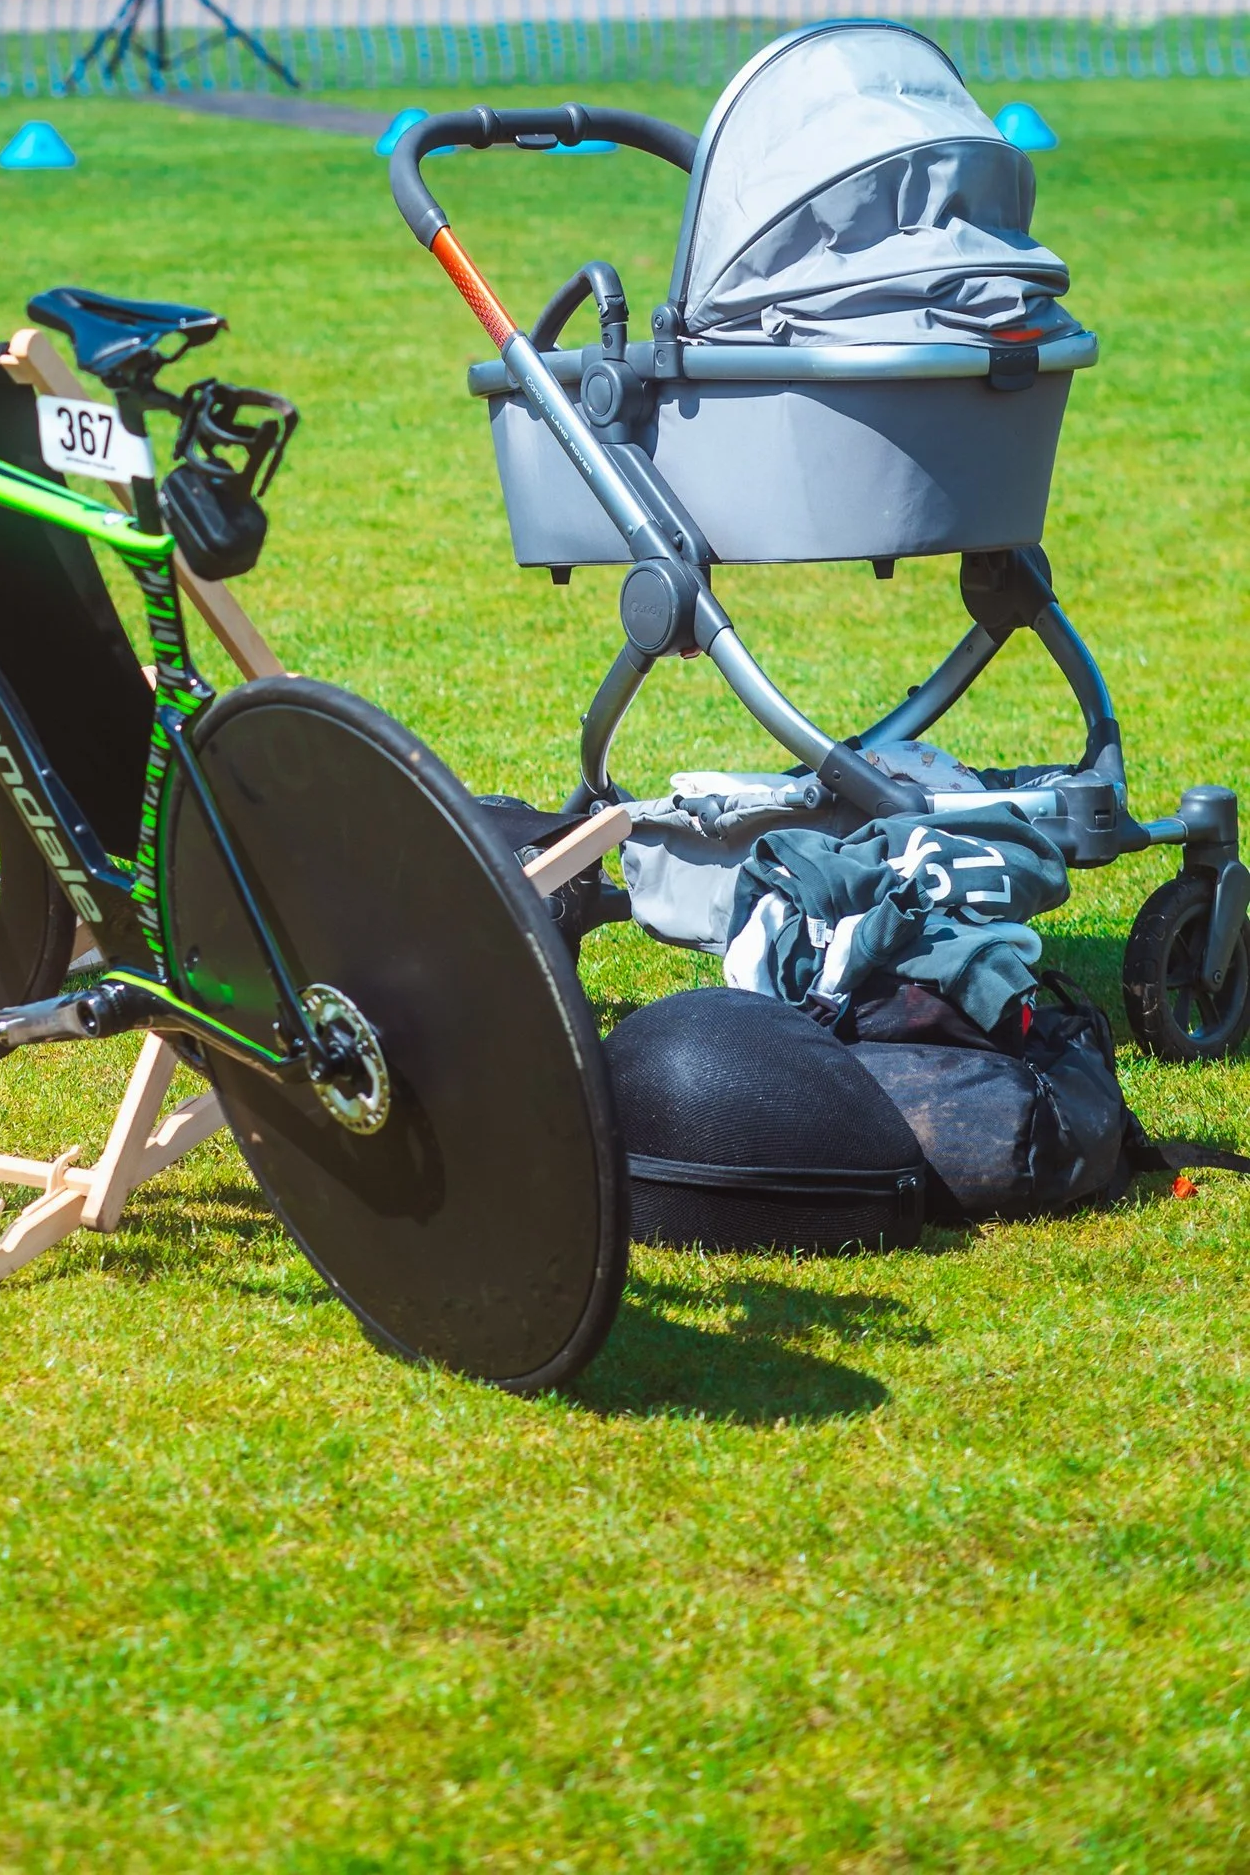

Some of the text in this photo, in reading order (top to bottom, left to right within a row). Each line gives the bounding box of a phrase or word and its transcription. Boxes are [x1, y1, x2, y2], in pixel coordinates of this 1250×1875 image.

[57, 407, 112, 459] 367
[551, 414, 569, 440] LAND
[570, 442, 593, 475] ROVER
